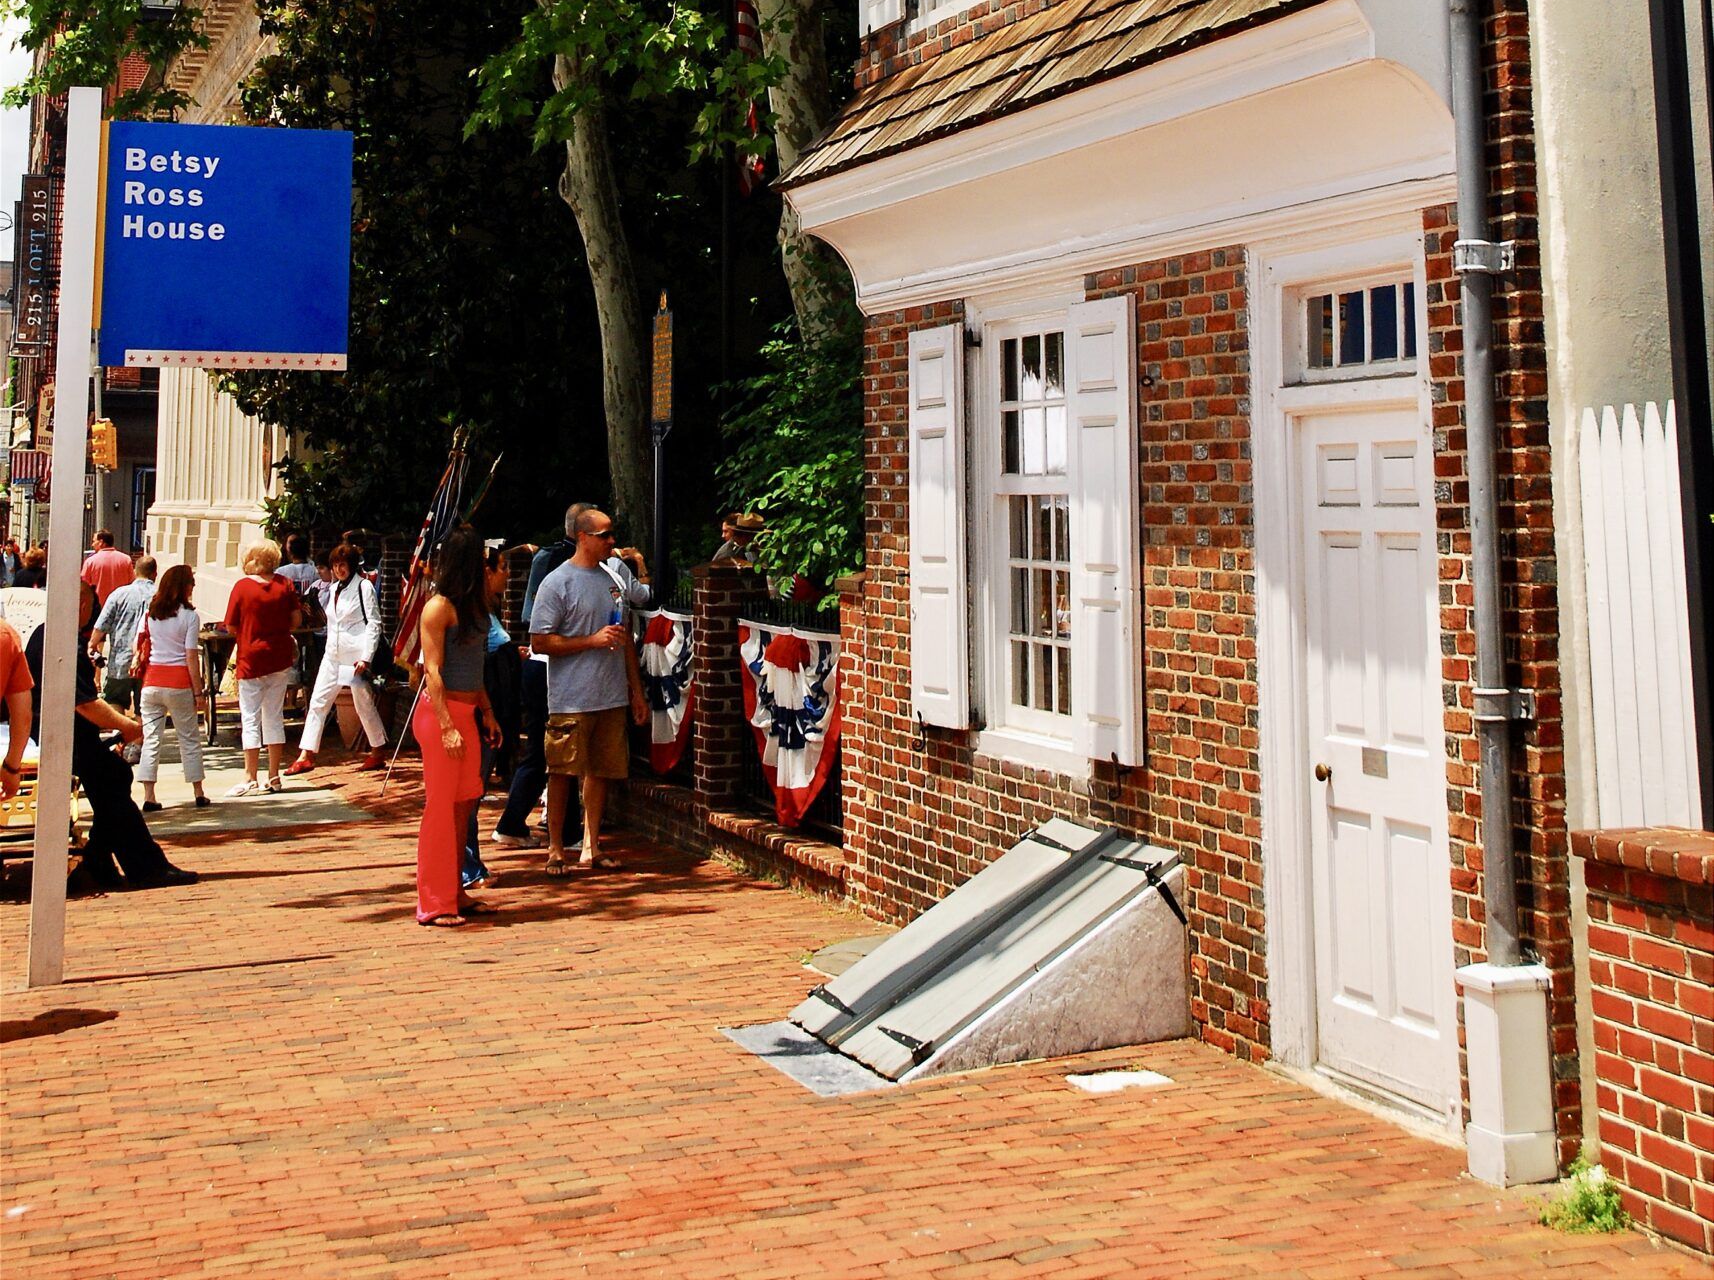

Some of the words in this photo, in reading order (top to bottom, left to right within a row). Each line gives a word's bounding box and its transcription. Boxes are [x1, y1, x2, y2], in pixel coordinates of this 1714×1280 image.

[125, 147, 220, 179] Betsy
[124, 181, 204, 207] Ross
[122, 214, 226, 241] House
